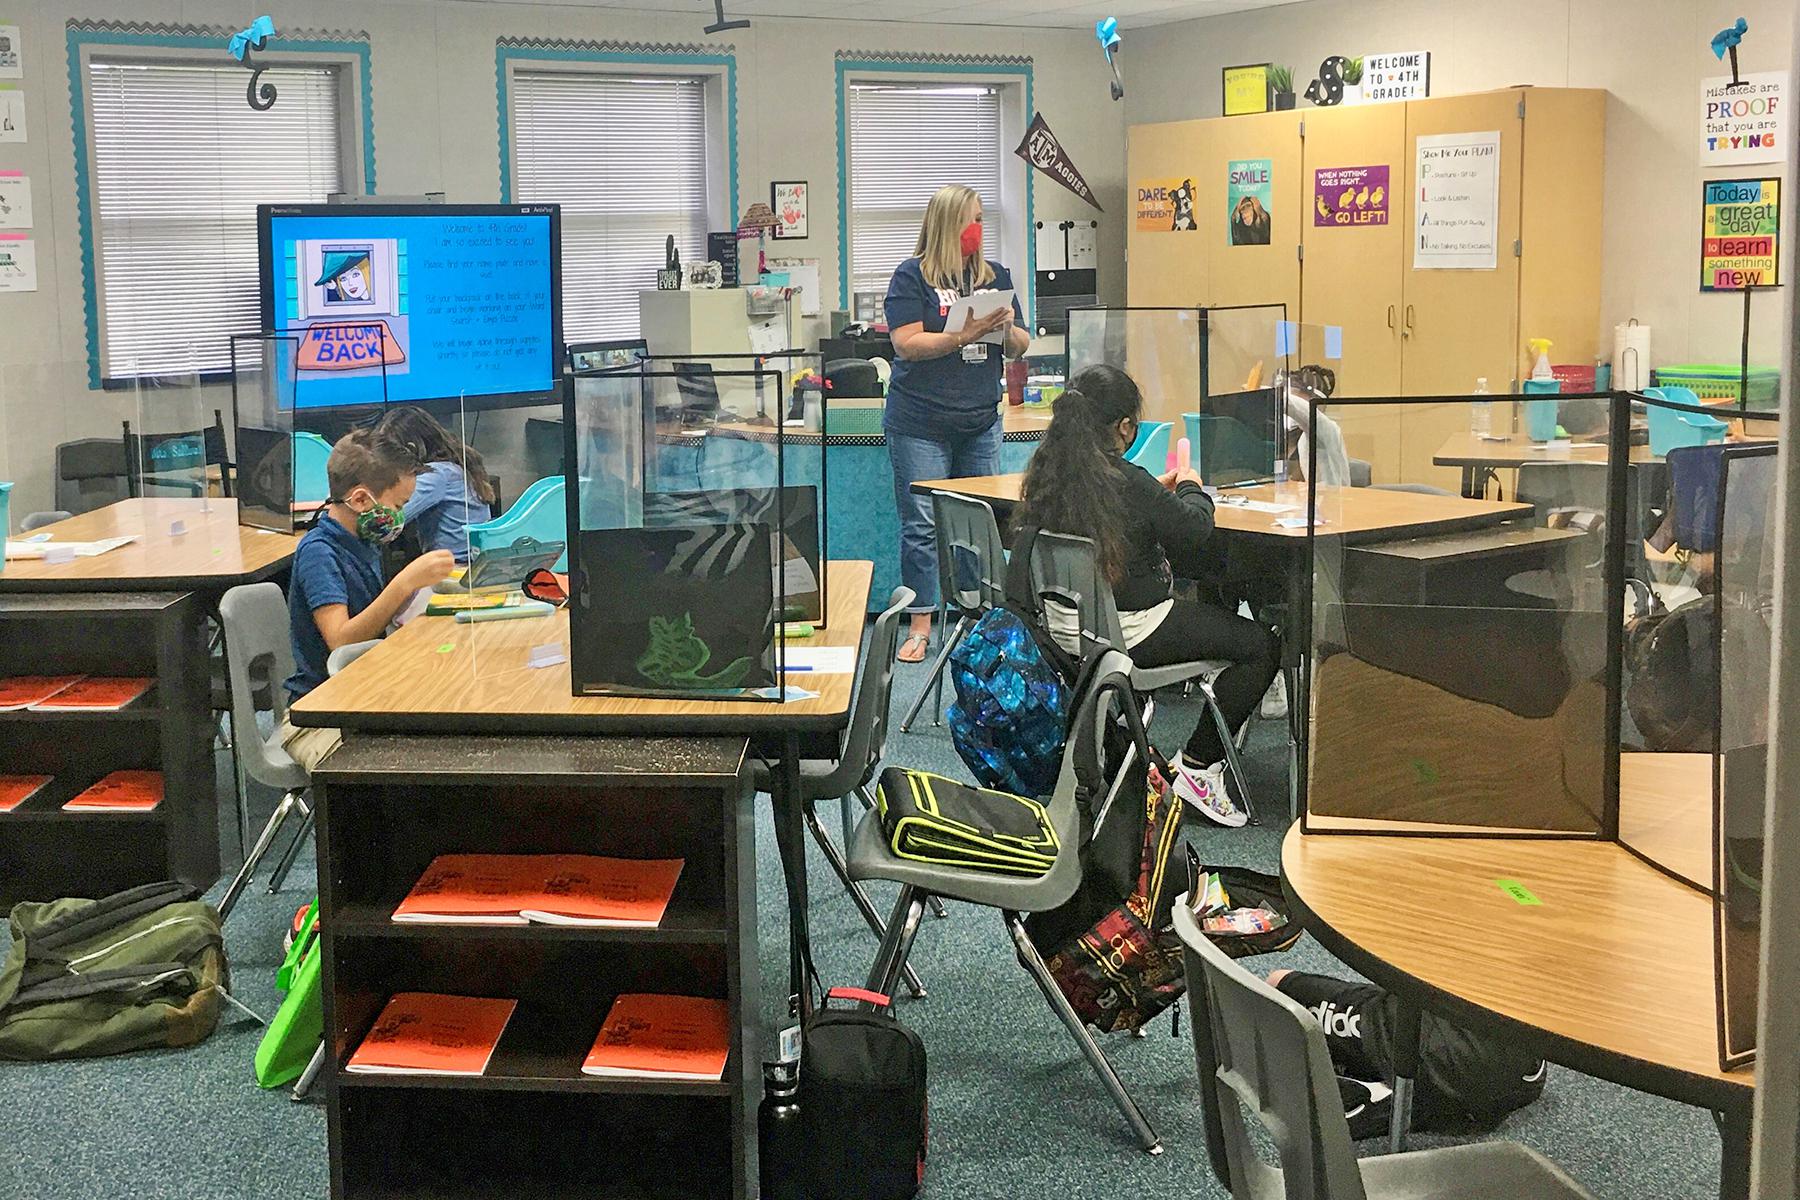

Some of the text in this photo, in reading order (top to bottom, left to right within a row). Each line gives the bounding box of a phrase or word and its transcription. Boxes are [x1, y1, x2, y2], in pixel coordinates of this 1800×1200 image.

[1370, 55, 1420, 71] WELCOME
[1370, 70, 1419, 85] TO 4TH
[1372, 87, 1415, 100] GRADE!
[1706, 83, 1780, 98] Mistakes are
[1706, 97, 1779, 120] PROOF
[1706, 120, 1777, 133] that you are
[1707, 133, 1775, 151] TRYING
[1249, 162, 1263, 170] YOU
[1230, 170, 1269, 184] SMILE
[1338, 169, 1368, 178] NOTHING
[1320, 178, 1338, 186] GOES
[1138, 187, 1168, 201] DARE
[1709, 185, 1770, 204] Today is
[1143, 201, 1164, 210] TO BE
[1137, 210, 1174, 219] DIFFERENT
[1335, 210, 1386, 223] GO LEFT!
[1708, 203, 1772, 226] a great
[442, 223, 473, 234] Welcome
[1730, 217, 1760, 236] day
[456, 239, 465, 247] so
[505, 238, 519, 246] see
[1708, 238, 1768, 256] to learn
[1709, 257, 1772, 270] something
[659, 280, 678, 289] EVER
[1718, 271, 1761, 286] new
[316, 341, 382, 362] BACK
